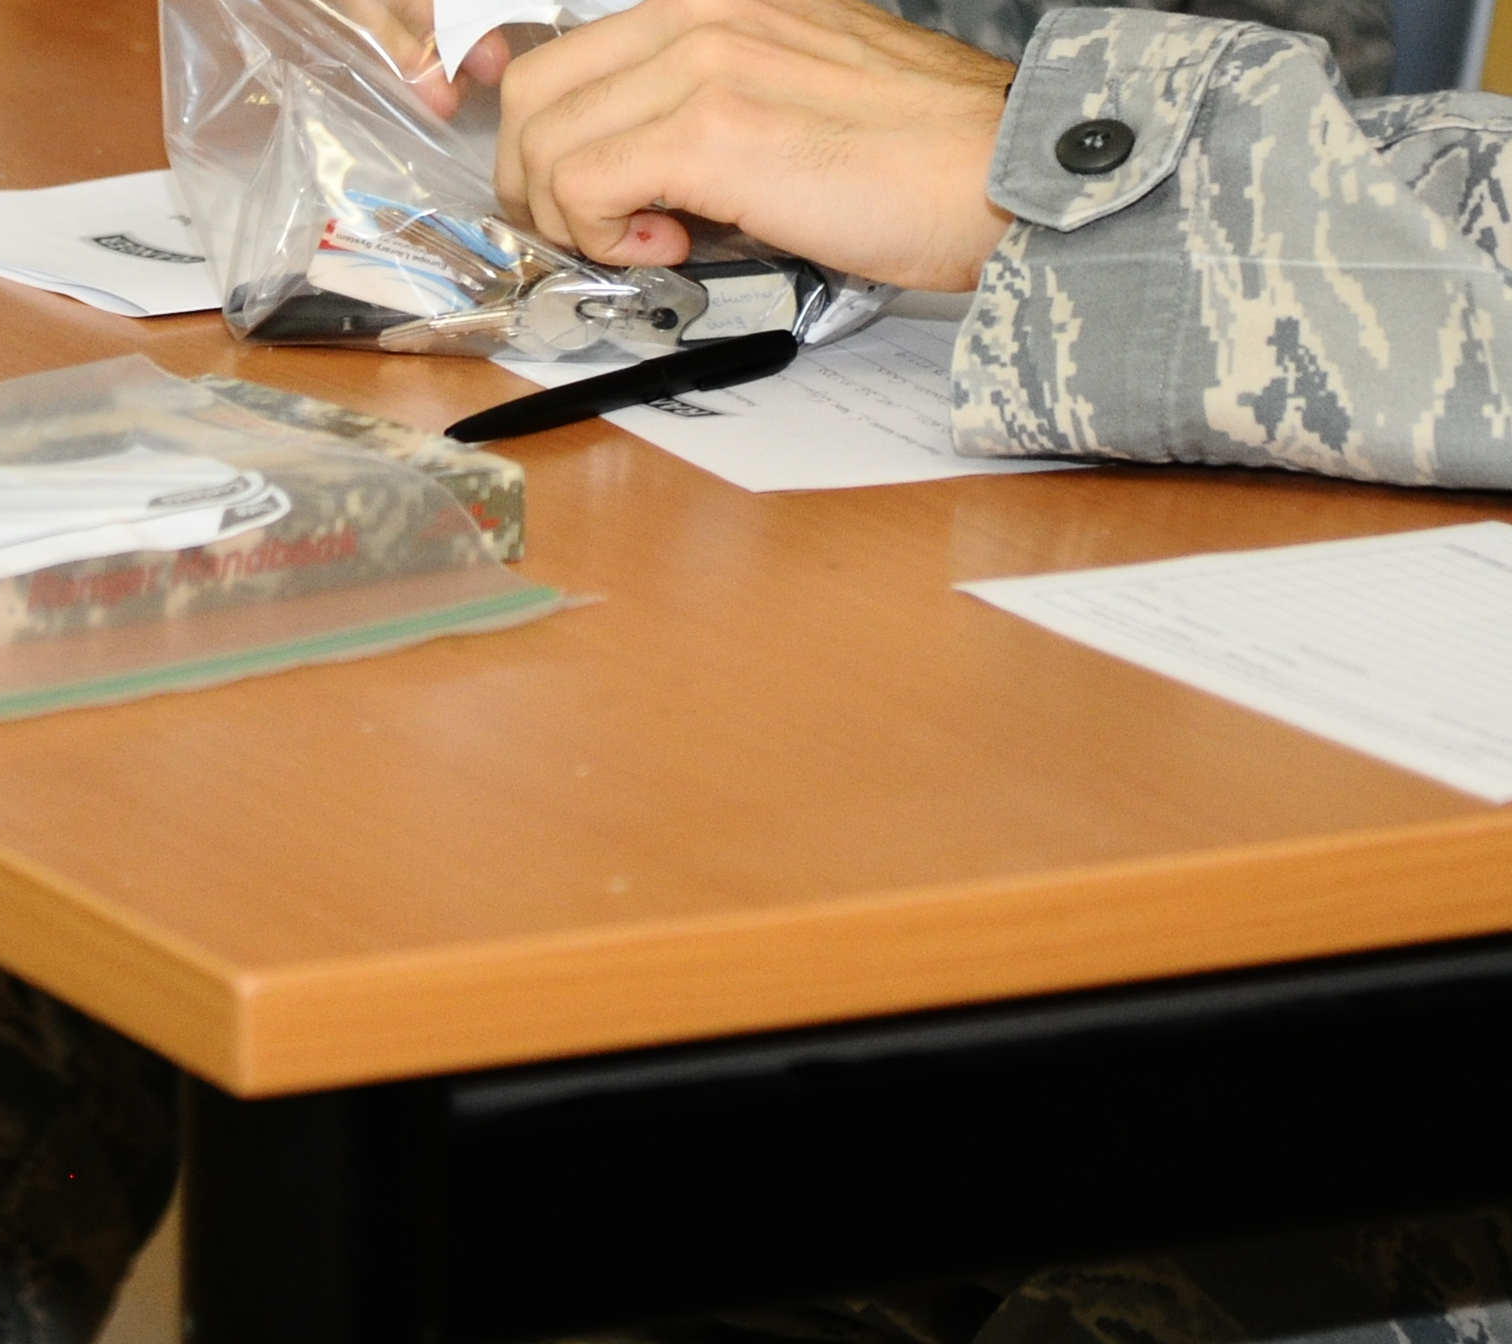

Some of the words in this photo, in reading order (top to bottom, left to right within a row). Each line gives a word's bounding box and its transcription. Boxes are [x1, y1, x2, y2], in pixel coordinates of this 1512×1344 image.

[335, 232, 373, 249] System
[376, 242, 410, 260] Library
[412, 255, 448, 271] Europe
